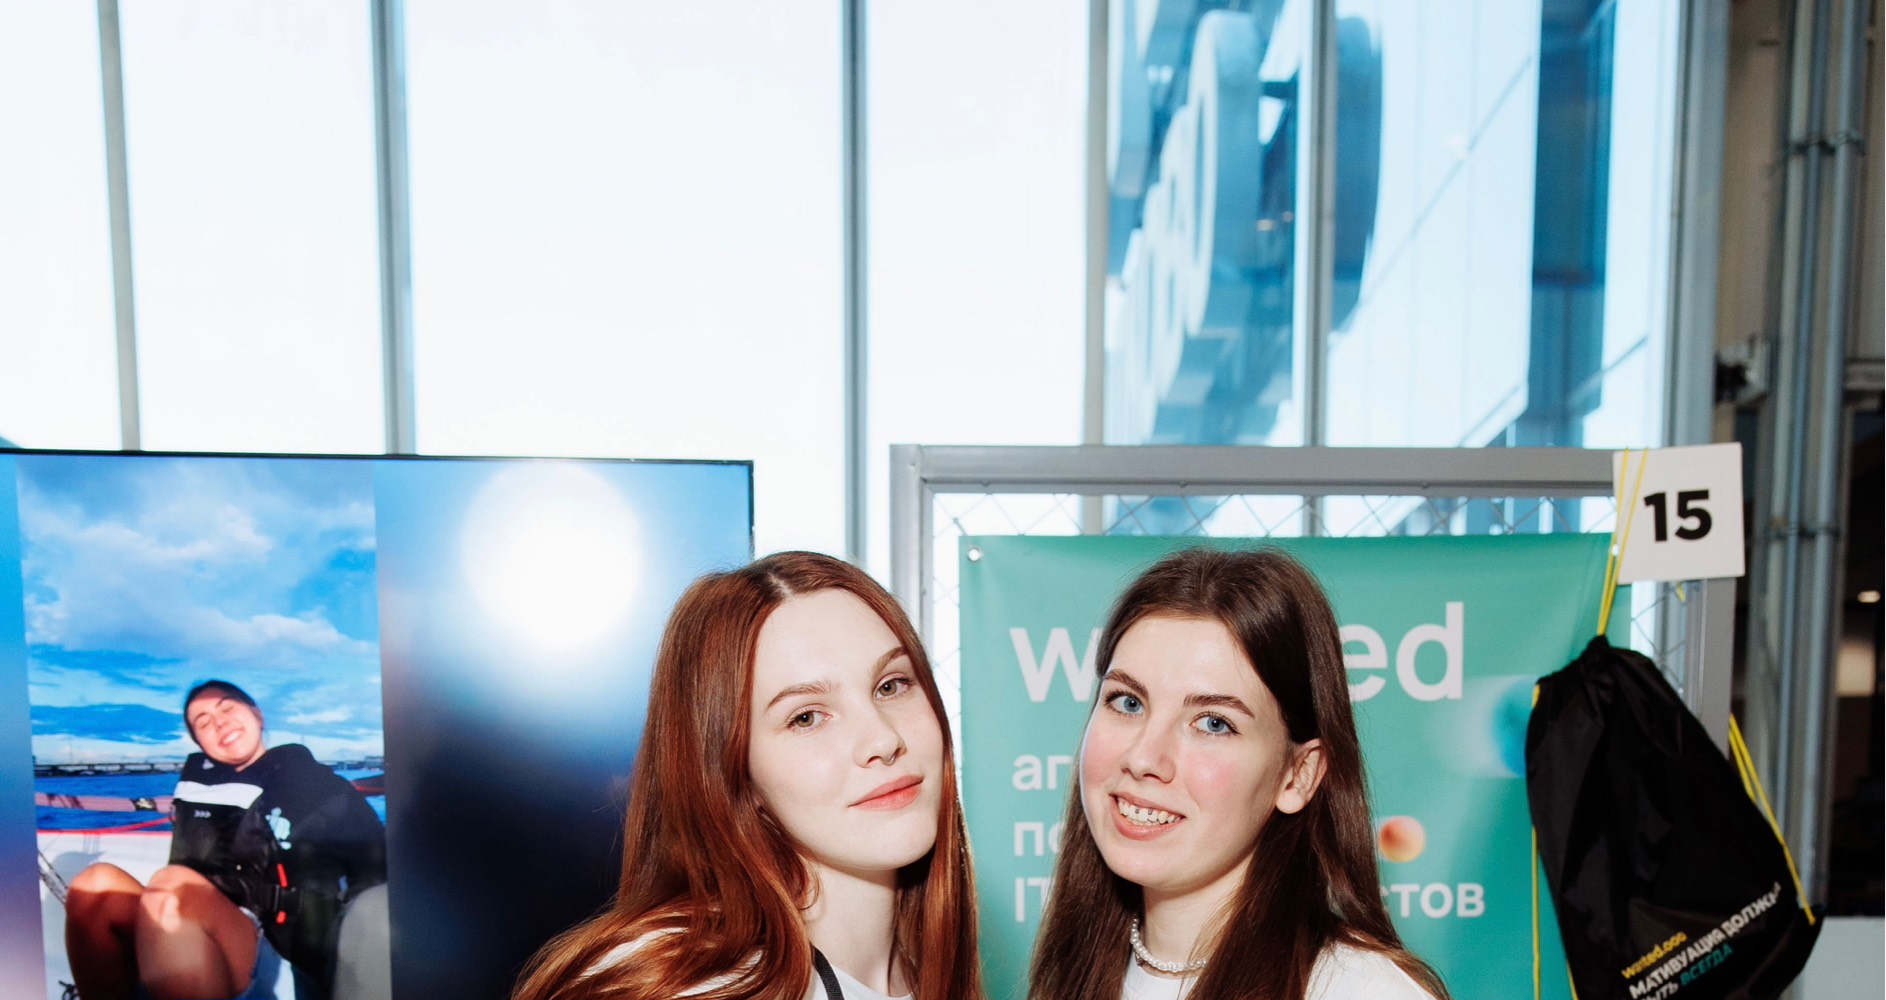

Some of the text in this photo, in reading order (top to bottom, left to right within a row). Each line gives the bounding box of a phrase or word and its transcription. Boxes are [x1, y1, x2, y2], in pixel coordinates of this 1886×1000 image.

[1643, 489, 1712, 542] 15
[1629, 928, 1726, 999] МАТИВУАЦИЯ
[1679, 943, 1734, 986] ВСЕГДА
